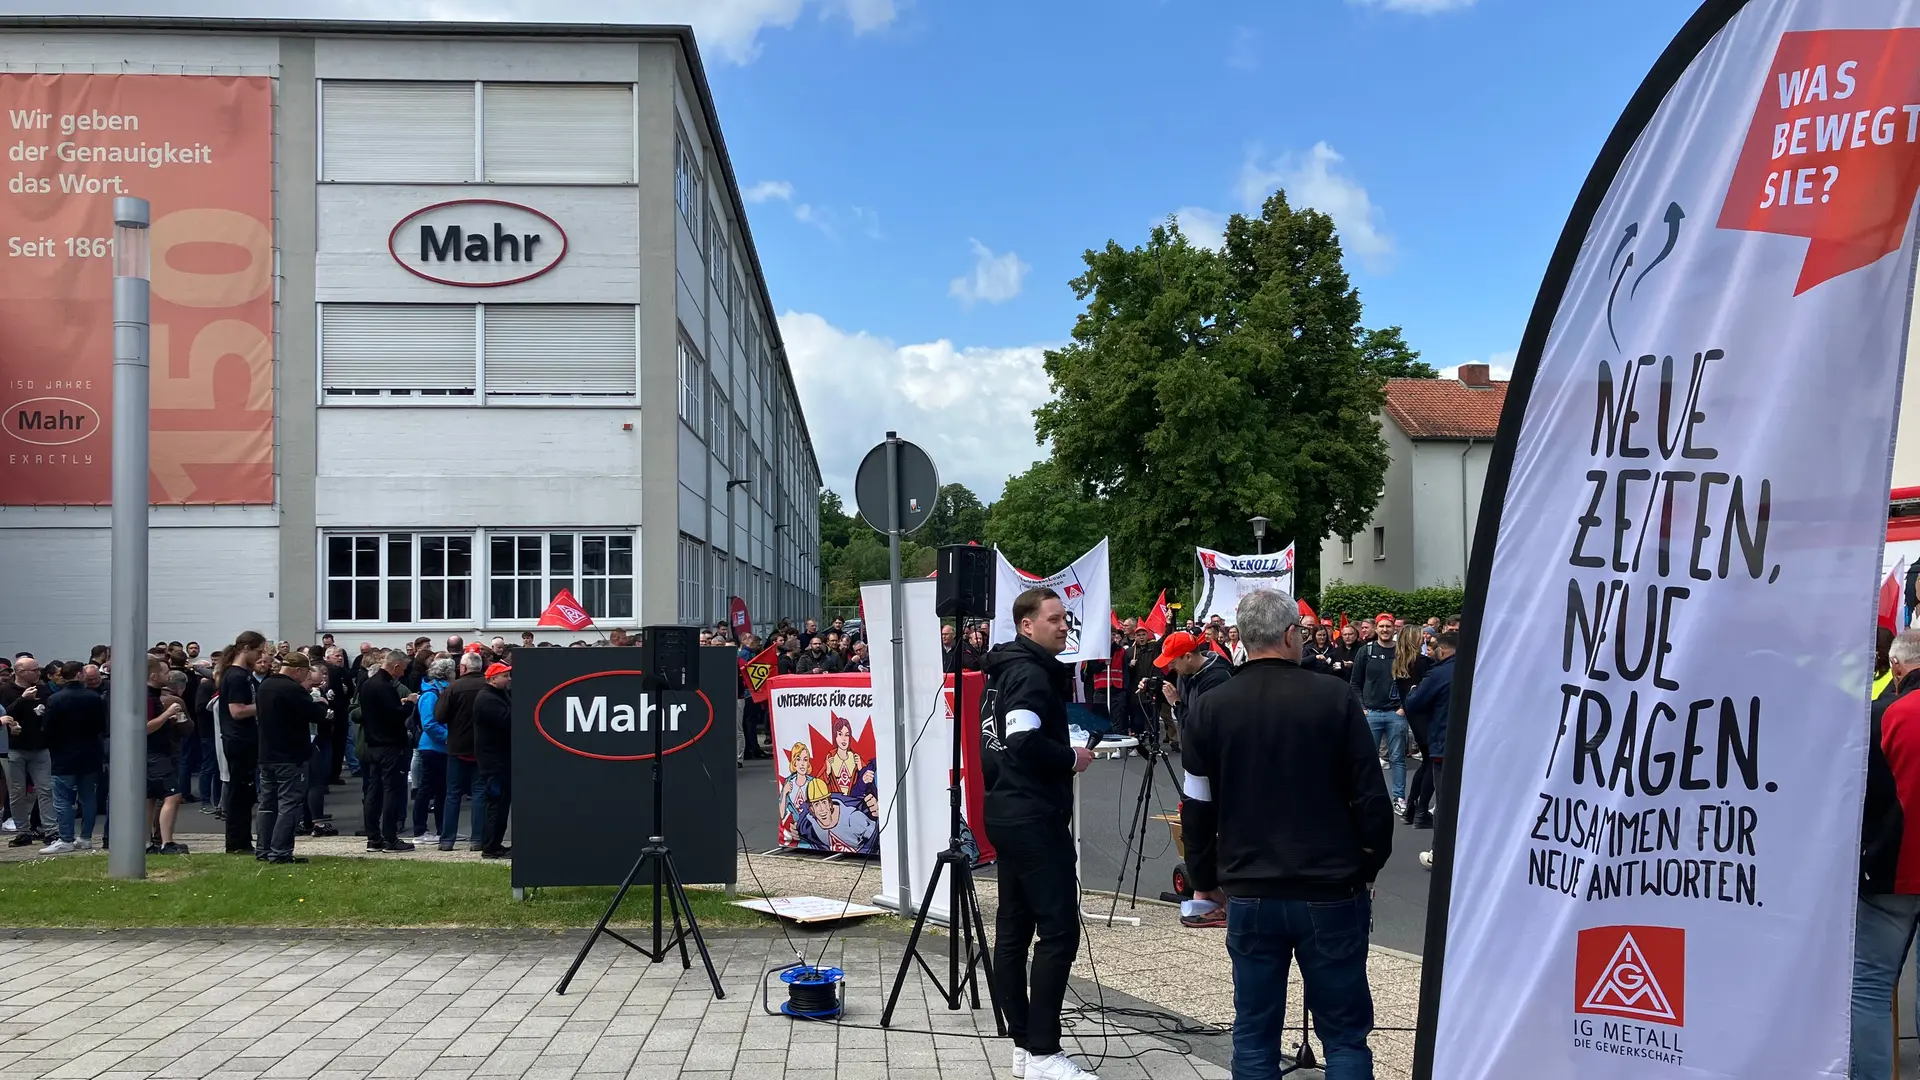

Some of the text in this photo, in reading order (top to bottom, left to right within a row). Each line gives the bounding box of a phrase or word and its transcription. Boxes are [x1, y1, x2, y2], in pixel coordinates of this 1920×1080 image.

[1778, 60, 1858, 109] WAS
[9, 108, 139, 135] Wir geben
[1771, 104, 1920, 160] BEWEGT
[8, 140, 212, 168] der Genauigkeit
[8, 171, 129, 194] das Wort.
[1760, 166, 1840, 209] SIE?
[8, 236, 56, 257] Seit
[420, 222, 541, 262] Mahr
[10, 380, 92, 389] 150 JAHRE
[18, 409, 85, 430] Mahr
[1590, 349, 1725, 460] NEUE
[9, 454, 92, 464] EXACTLY
[1569, 469, 1781, 584] ZEITEN,
[1230, 558, 1279, 571] RENOLD
[1562, 578, 1690, 690] NEUE
[565, 693, 687, 733] Mahr
[777, 689, 873, 708] UNTERWEGS FÜR GERE
[1545, 683, 1778, 796] FRAGEN.
[1531, 792, 1758, 857] ZUSAMMEN FÜR
[1529, 848, 1763, 907] NEUE ANTWORTEN.
[1574, 1019, 1684, 1053] IG METALL
[1574, 1038, 1683, 1066] DIE GEWERKSCHAFT
